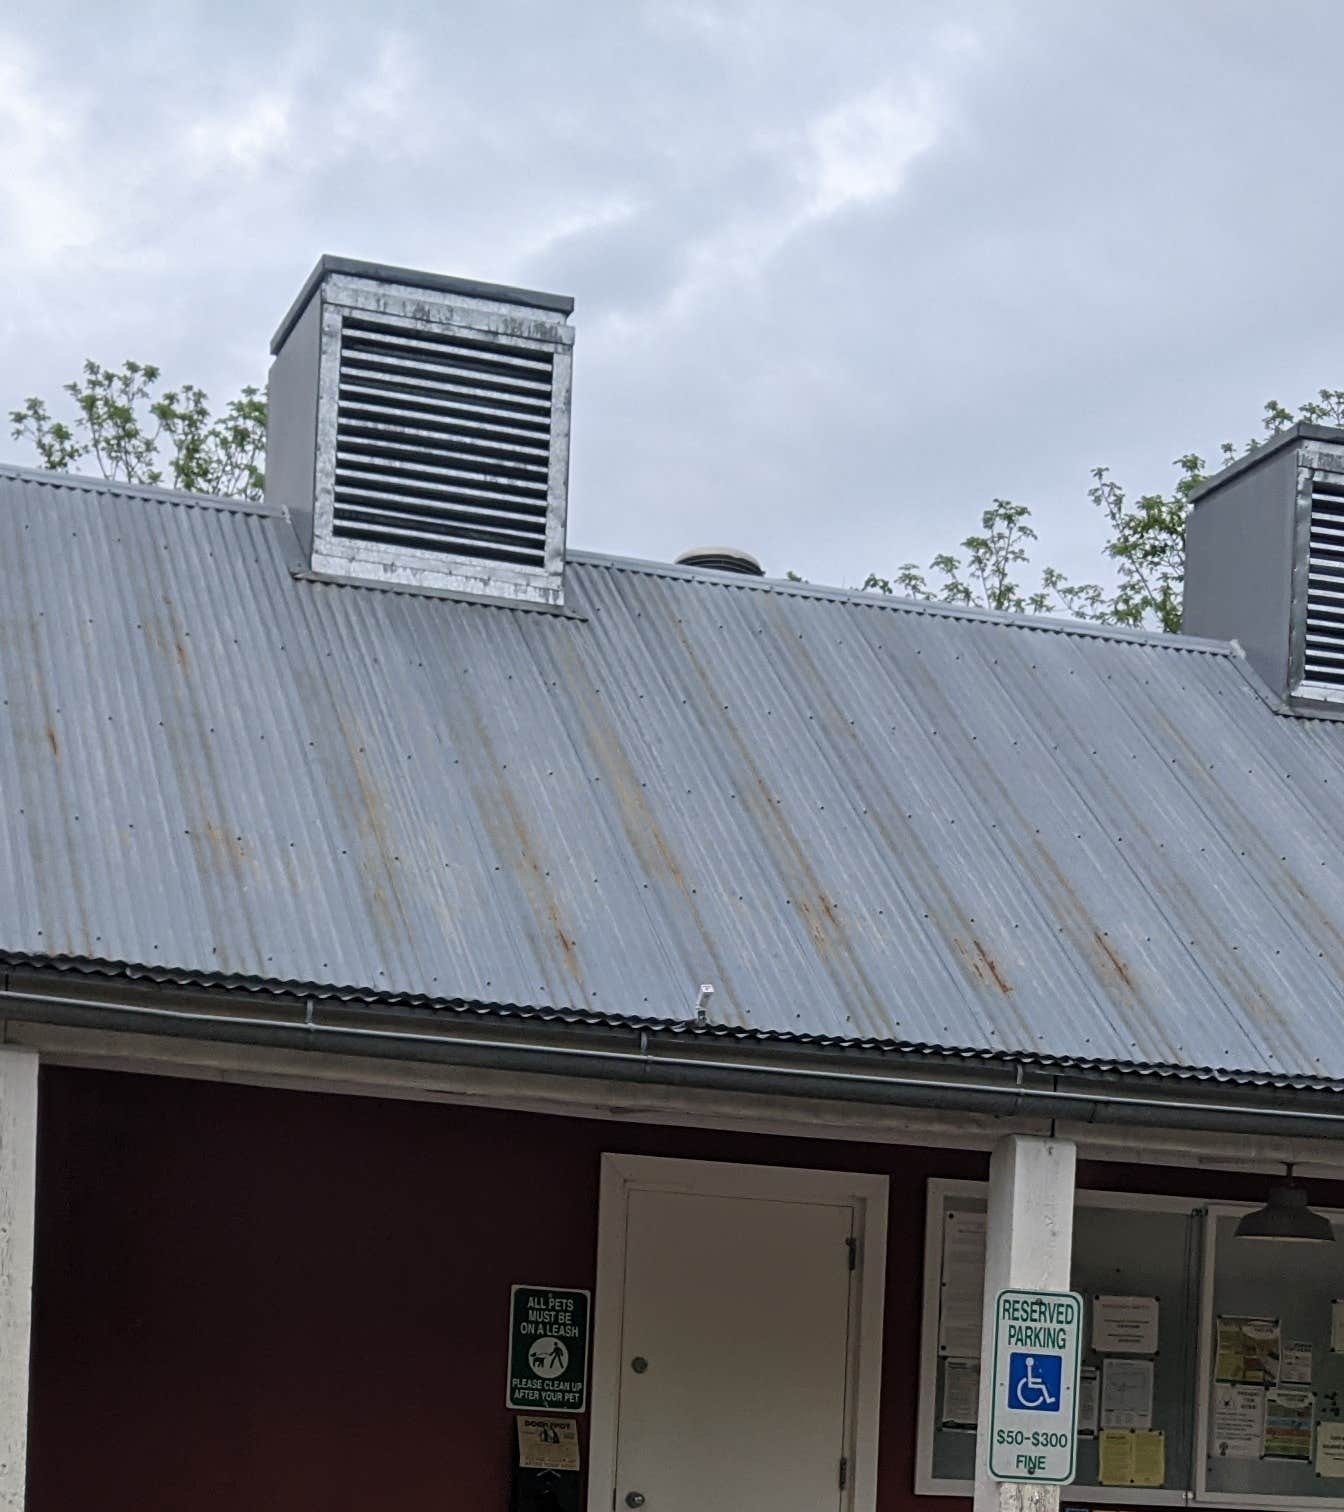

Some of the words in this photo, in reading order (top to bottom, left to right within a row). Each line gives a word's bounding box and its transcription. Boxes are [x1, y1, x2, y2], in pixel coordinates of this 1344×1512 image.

[527, 1297, 546, 1309] ALL
[548, 1298, 574, 1311] PETS
[1002, 1299, 1074, 1324] RESERVED
[528, 1310, 556, 1322] MUST
[558, 1312, 572, 1324] BE
[520, 1322, 535, 1335] ON
[536, 1323, 544, 1335] A
[546, 1324, 579, 1337] LEASH
[1008, 1325, 1066, 1349] PARKING
[512, 1378, 543, 1389] PLEASE
[544, 1380, 570, 1391] CLEAN
[571, 1382, 582, 1392] UP
[514, 1389, 539, 1400] AFTER
[541, 1391, 563, 1401] YOUR
[564, 1392, 580, 1403] PET
[997, 1429, 1068, 1448] $50-$300
[1016, 1455, 1046, 1470] FINE
